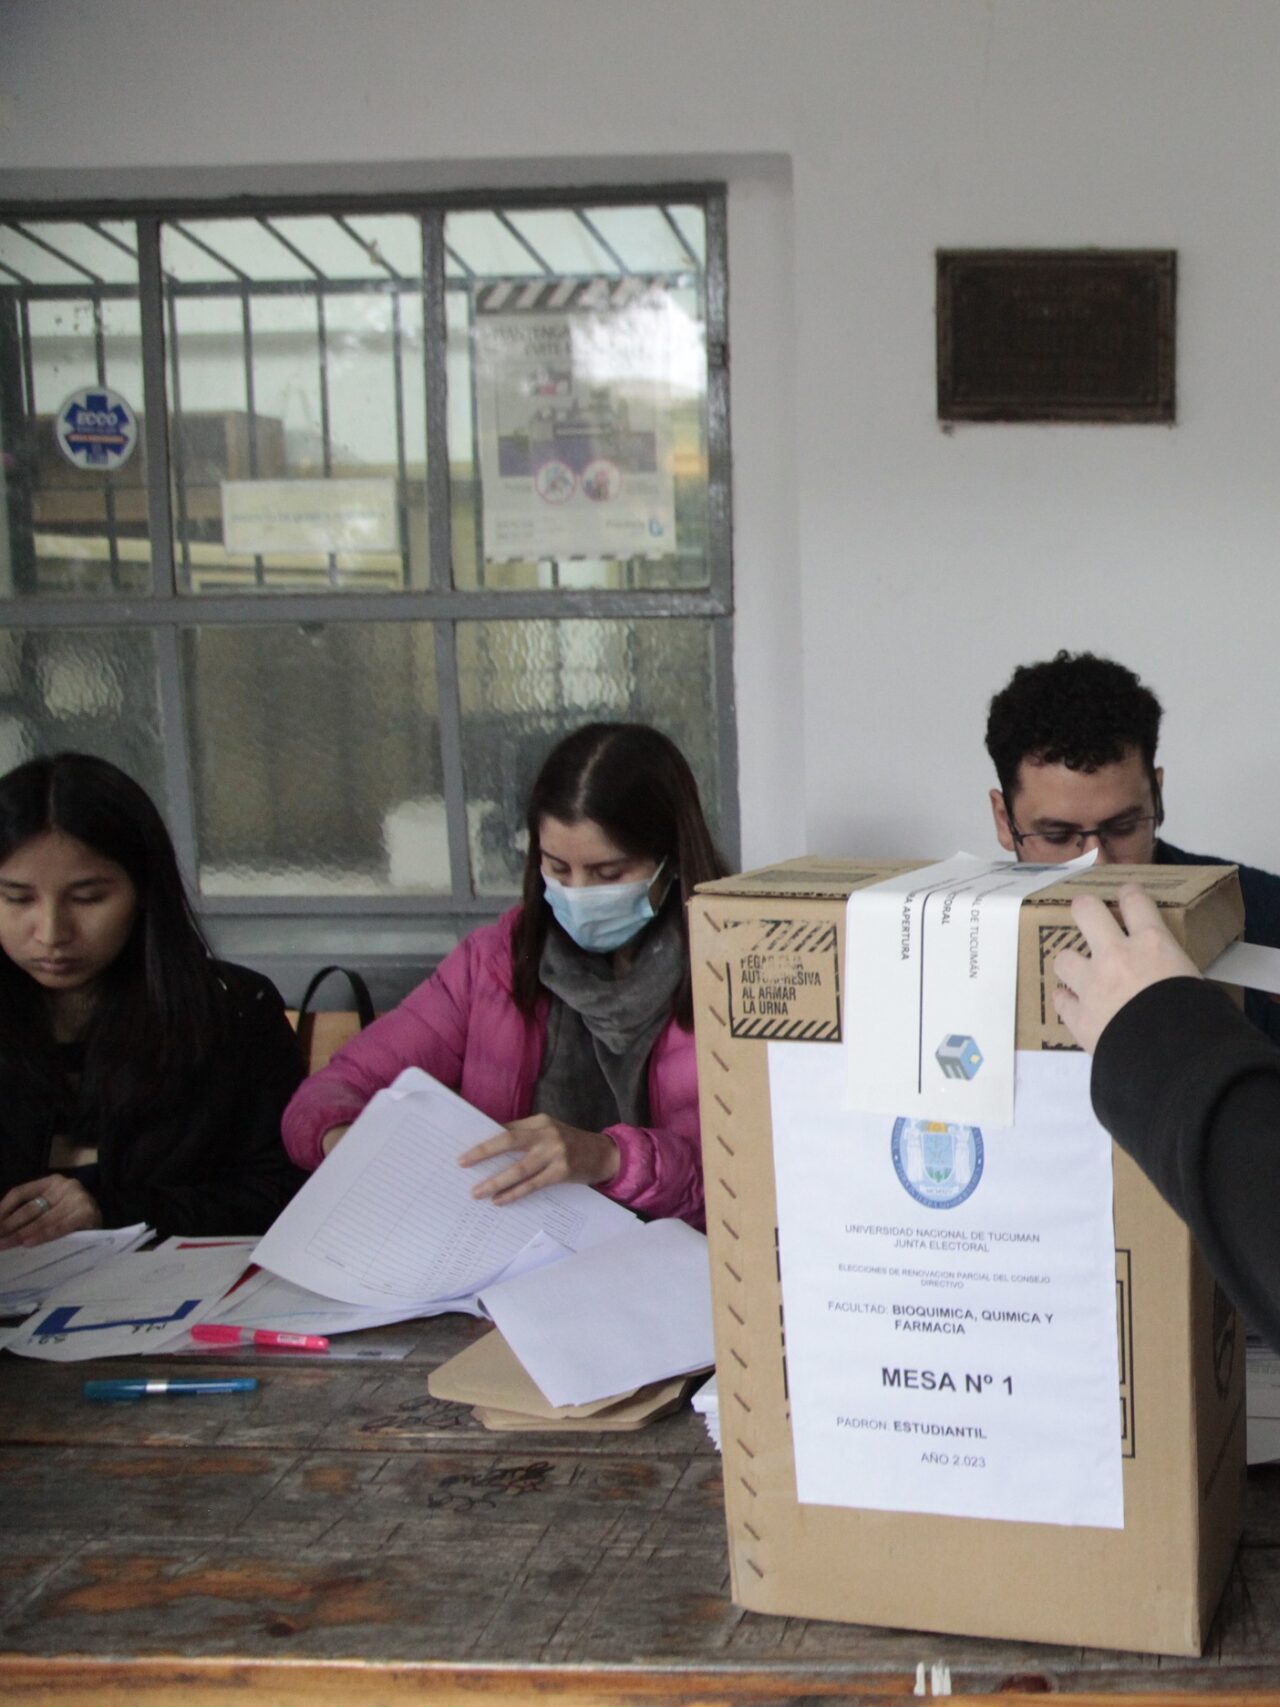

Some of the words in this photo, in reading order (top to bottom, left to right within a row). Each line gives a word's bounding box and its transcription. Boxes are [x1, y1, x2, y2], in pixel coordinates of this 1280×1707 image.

[77, 410, 119, 427] ECCO
[969, 908, 980, 923] DE
[901, 905, 912, 961] APERTURA
[968, 925, 981, 979] TUCUMÁN
[742, 986, 755, 1000] AL
[759, 986, 797, 1001] ARMAR
[743, 1000, 756, 1015] LA
[759, 1001, 789, 1016] URNA
[844, 1223, 914, 1238] UNIVERSIDAD
[916, 1227, 969, 1241] NACIONAL
[970, 1230, 988, 1242] DE
[989, 1231, 1041, 1244] TUCUMAN
[893, 1239, 927, 1249] JUNTA
[929, 1241, 990, 1254] ELECTORAL
[837, 1263, 888, 1276] ELECCIONES
[888, 1266, 901, 1276] DE
[901, 1268, 955, 1280] RENOVACION
[955, 1271, 991, 1282] PARCIAL
[992, 1274, 1009, 1283] DEL
[1010, 1274, 1052, 1285] CONSEJO
[920, 1278, 965, 1289] DIRECTIVO
[827, 1300, 888, 1315] FACULTAD:
[892, 1304, 978, 1322] BIOQUIMICA,
[981, 1309, 1042, 1325] QUIMICA
[1044, 1312, 1055, 1324] Y
[894, 1319, 967, 1335] FARMACIA
[881, 1366, 957, 1392] MESA
[965, 1372, 994, 1394] Nº
[1001, 1375, 1014, 1396] 1
[836, 1416, 889, 1432] PADRON:
[893, 1420, 989, 1440] ESTUDIANTIL
[920, 1450, 950, 1466] AÑO
[952, 1454, 987, 1469] 2.023
